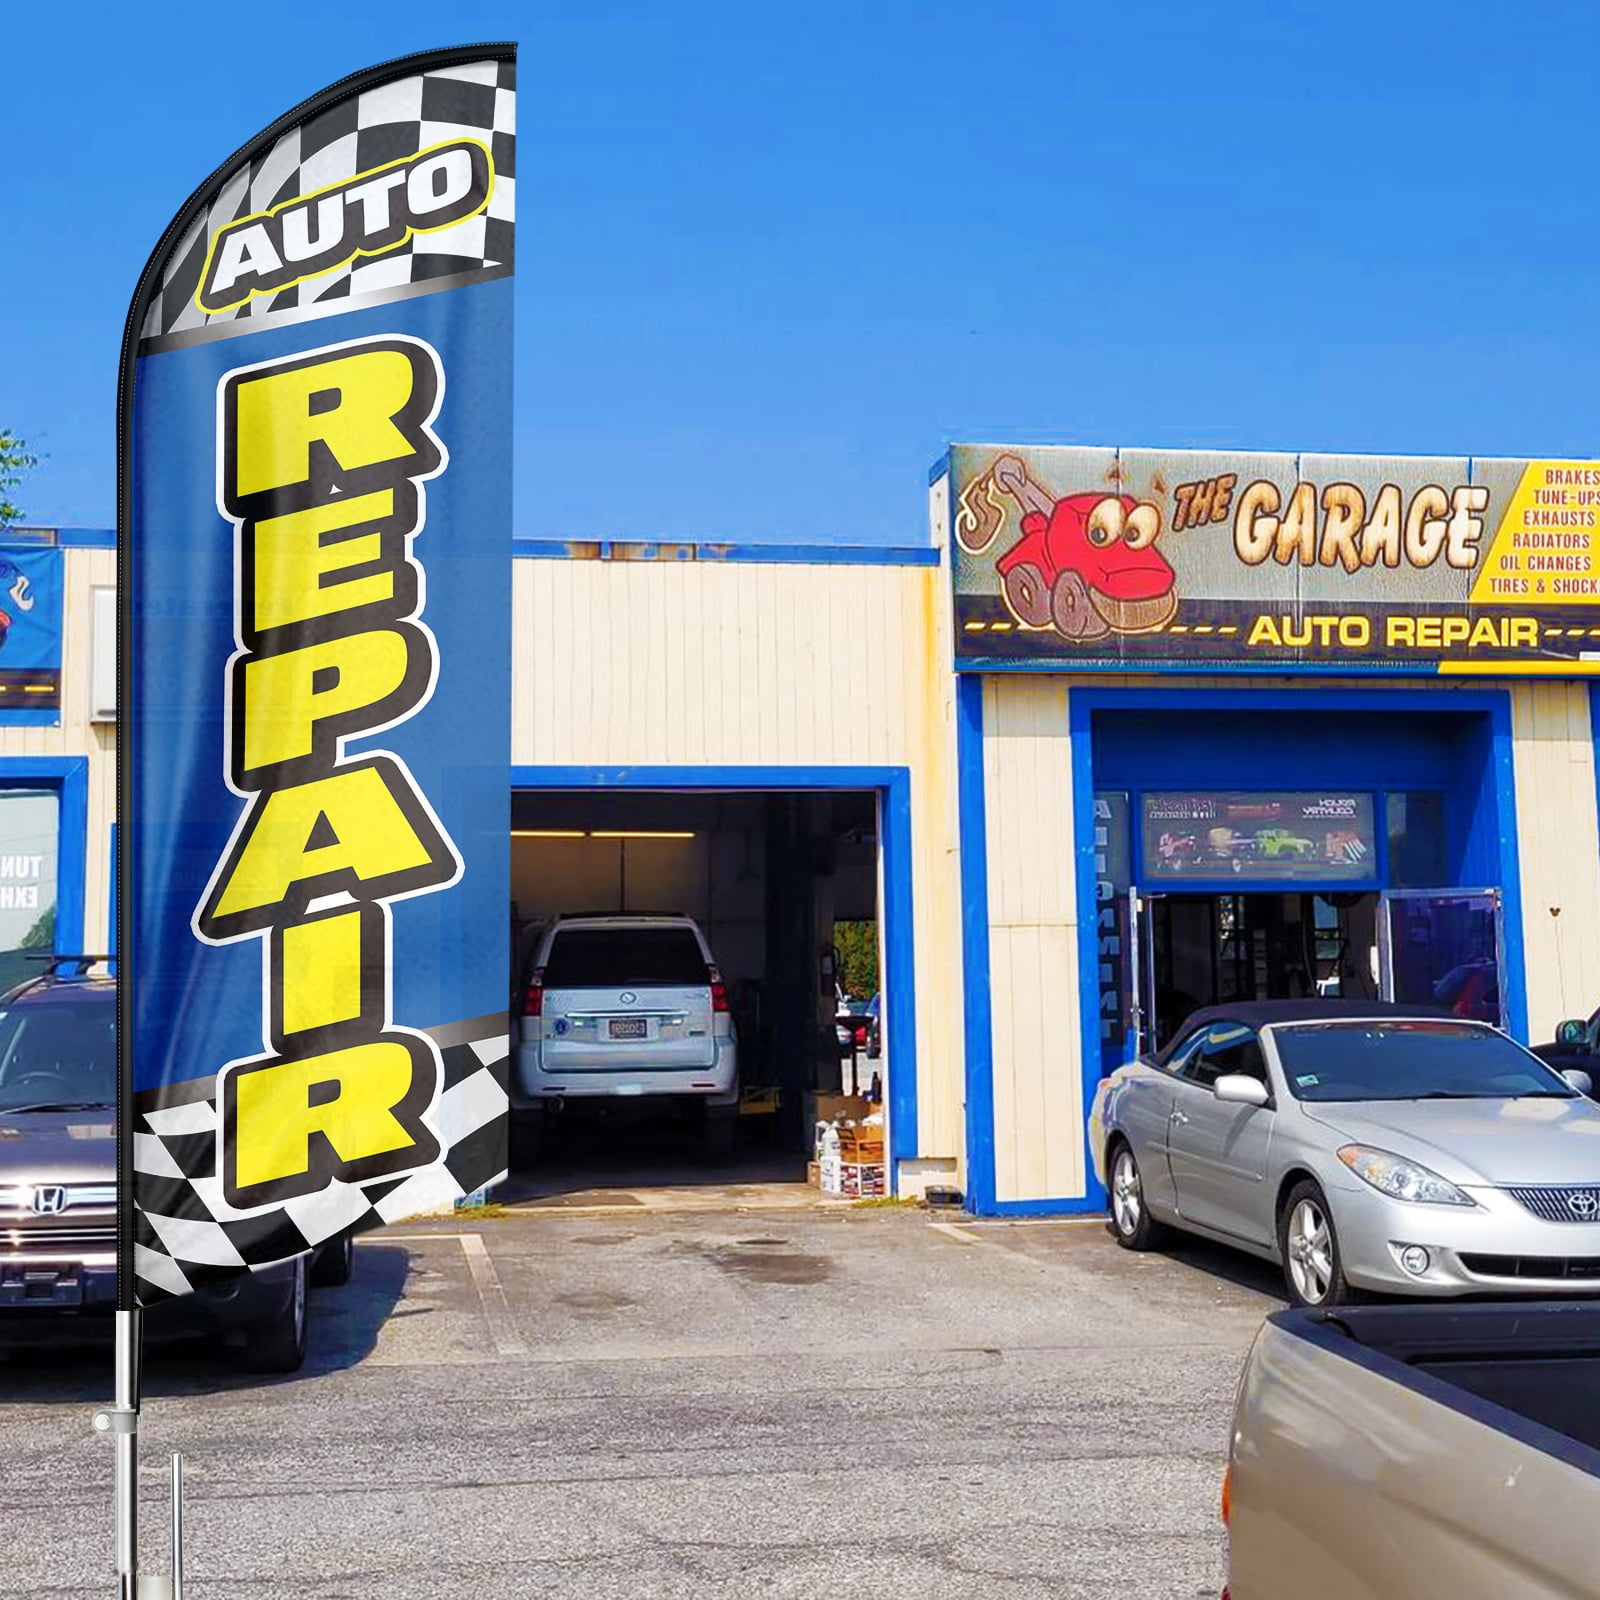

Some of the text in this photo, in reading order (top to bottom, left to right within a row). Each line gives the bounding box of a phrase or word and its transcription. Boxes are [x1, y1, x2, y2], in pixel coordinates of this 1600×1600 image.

[208, 147, 475, 297] AUTO
[1545, 469, 1600, 485] BRAKES
[1172, 473, 1490, 574] THE GARAGE
[1523, 510, 1595, 526] EXHAUSTS
[1513, 533, 1590, 549] RADIATORS
[1500, 555, 1591, 571] OIL CHANGES
[1490, 578, 1600, 594] TIRES & SHOCK
[1248, 615, 1538, 648] AUTO REPAIR
[210, 347, 434, 1190] REPAIR
